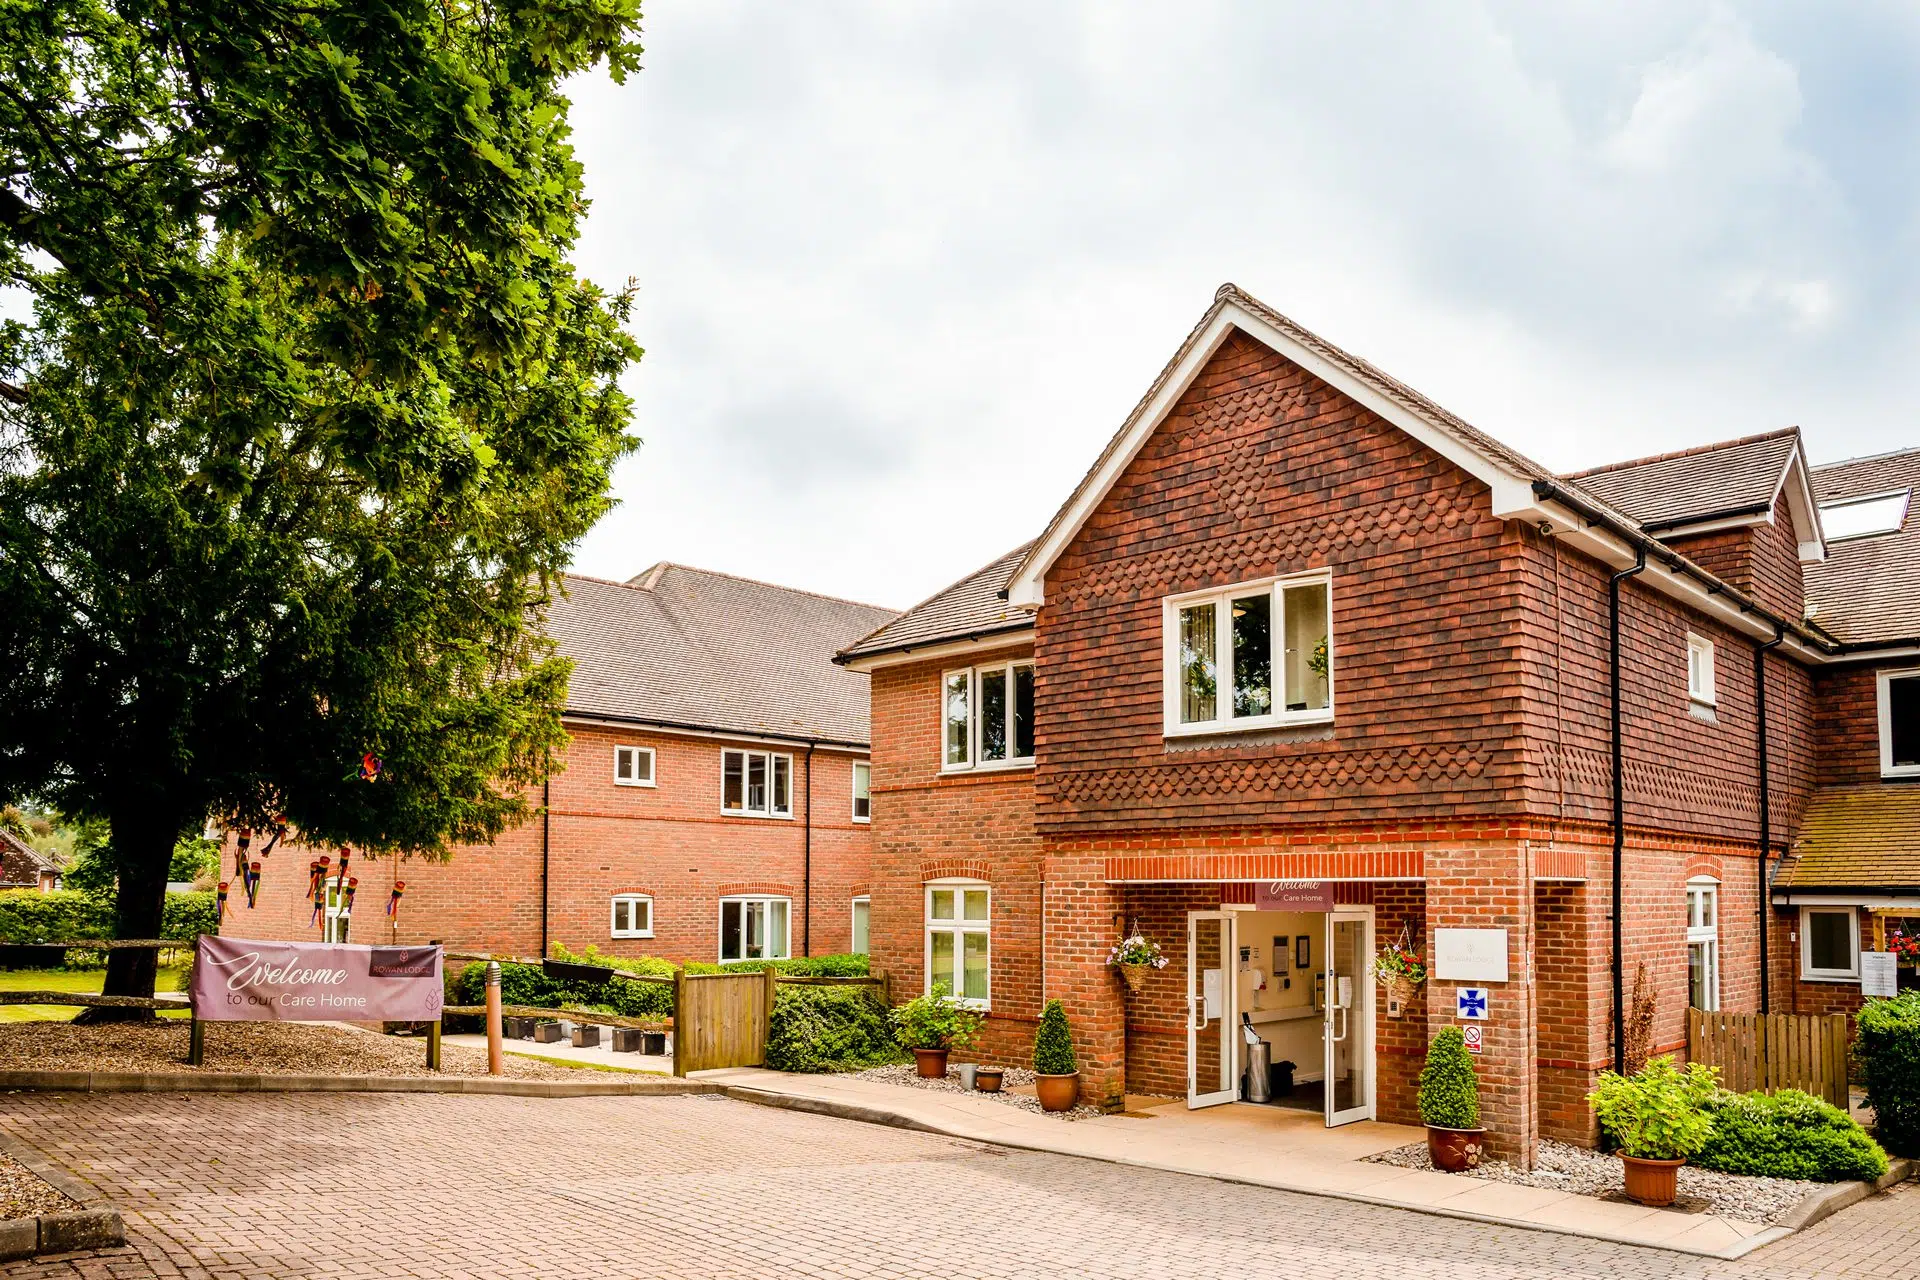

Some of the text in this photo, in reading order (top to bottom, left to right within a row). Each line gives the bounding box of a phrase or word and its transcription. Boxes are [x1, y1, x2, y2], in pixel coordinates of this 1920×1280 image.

[1283, 894, 1300, 902] Care
[1301, 894, 1323, 902] Home
[207, 952, 348, 991] Welcome
[372, 965, 403, 974] ROWAN
[226, 992, 367, 1007] to our Care Home
